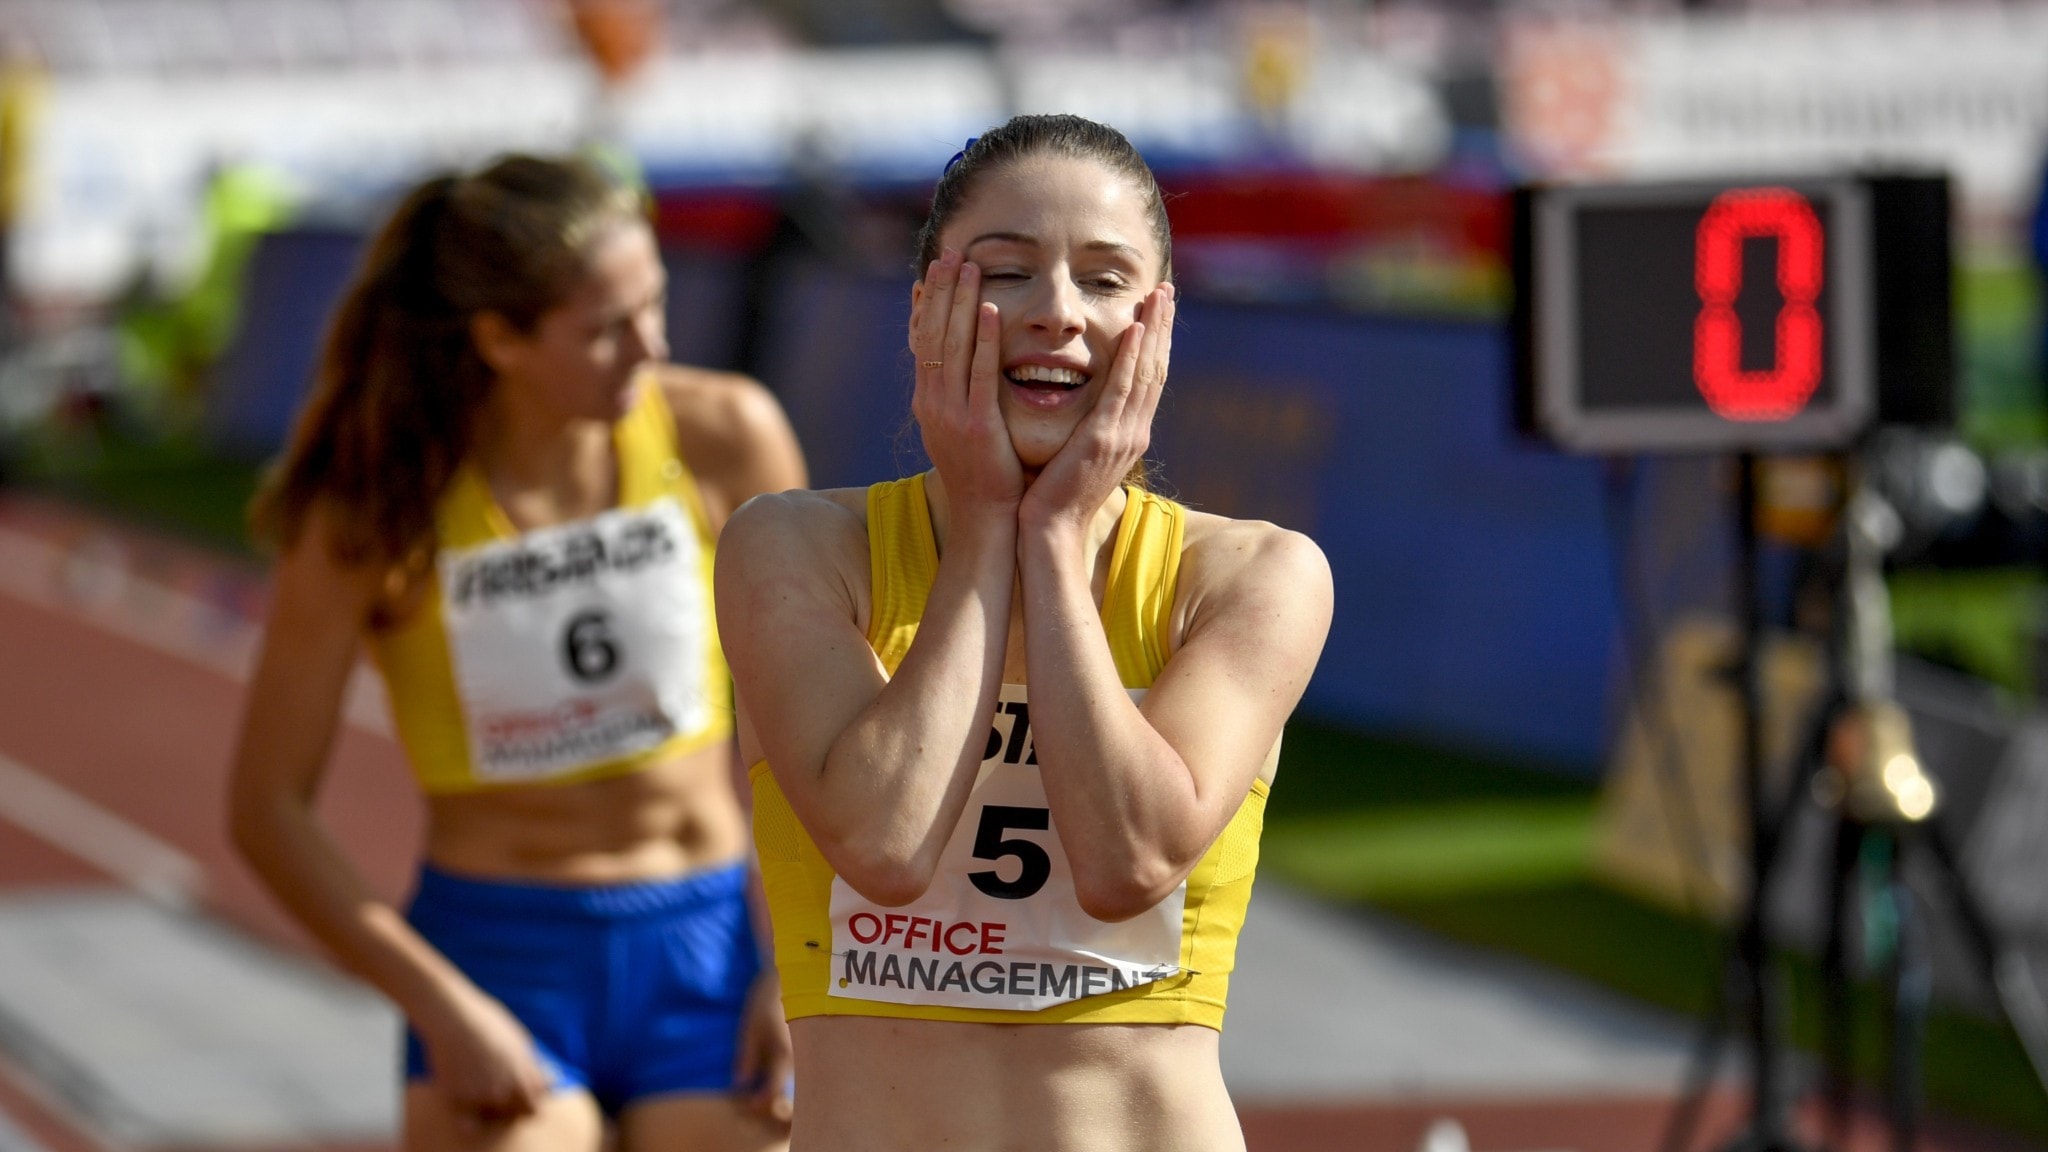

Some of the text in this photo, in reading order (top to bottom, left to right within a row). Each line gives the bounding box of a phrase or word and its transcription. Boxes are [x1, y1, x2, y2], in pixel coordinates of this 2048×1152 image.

[1693, 186, 1824, 423] 0
[562, 610, 623, 686] 6
[967, 805, 1051, 900] 5
[848, 912, 1007, 956] OFFICE
